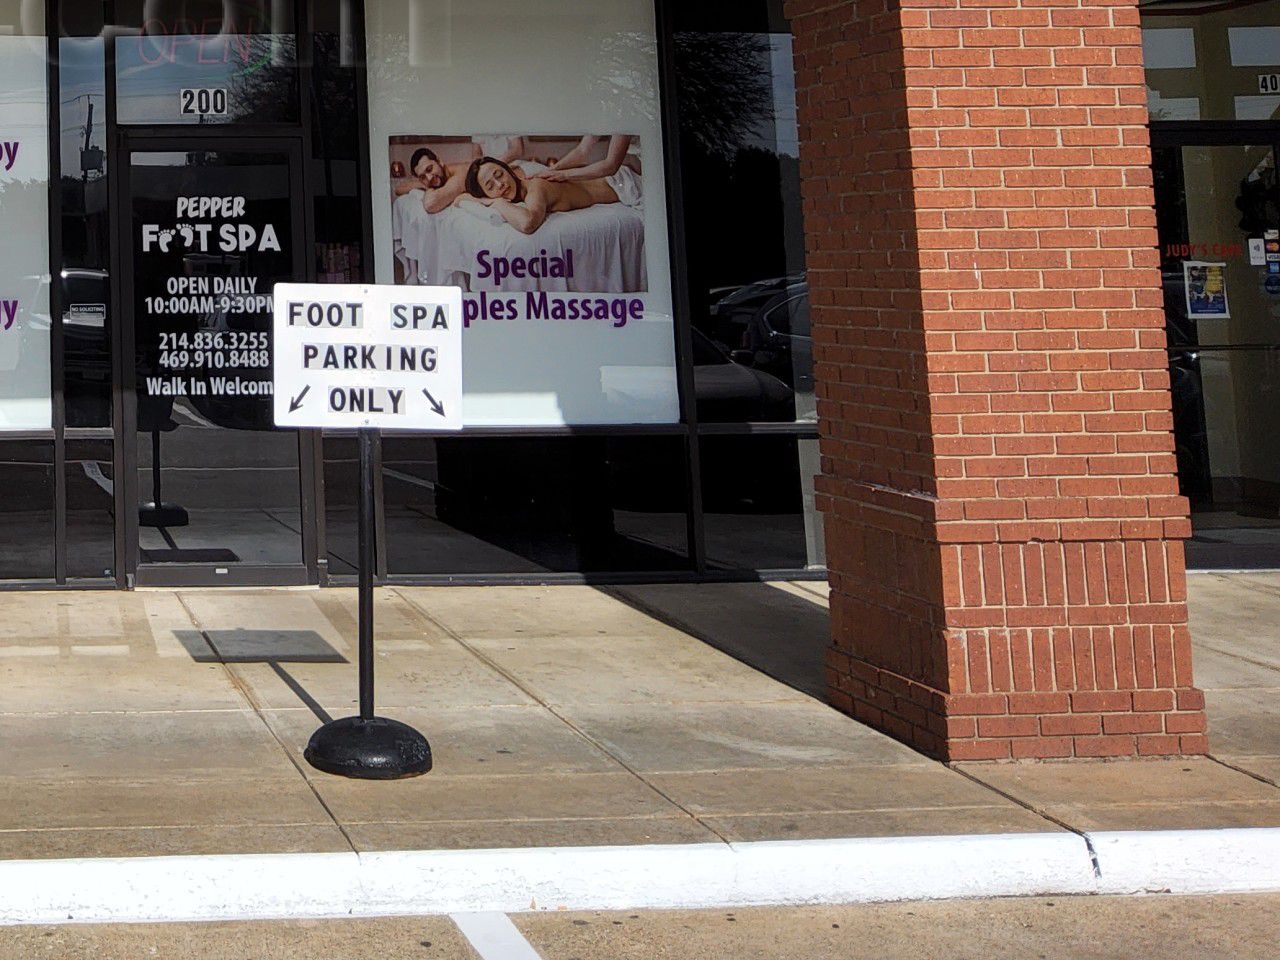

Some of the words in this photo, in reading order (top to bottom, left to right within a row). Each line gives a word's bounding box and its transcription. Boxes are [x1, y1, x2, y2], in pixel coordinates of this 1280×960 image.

[138, 16, 254, 66] OPEN
[182, 88, 226, 115] 200
[176, 195, 246, 219] PEPPER
[218, 223, 282, 252] SPA
[476, 248, 574, 286] Special
[166, 276, 209, 295] OPEN
[213, 276, 258, 295] DAILY
[287, 301, 364, 327] FOOT
[392, 303, 449, 330] SPA
[462, 290, 518, 328] ples
[525, 290, 645, 328] Massage
[158, 331, 269, 350] 214.836.3255
[158, 350, 270, 369] 469.910.8488
[303, 343, 438, 372] PARKING
[146, 376, 188, 396] Walk
[190, 377, 207, 396] In
[209, 376, 275, 396] Welcom
[328, 386, 404, 414] ONLY
